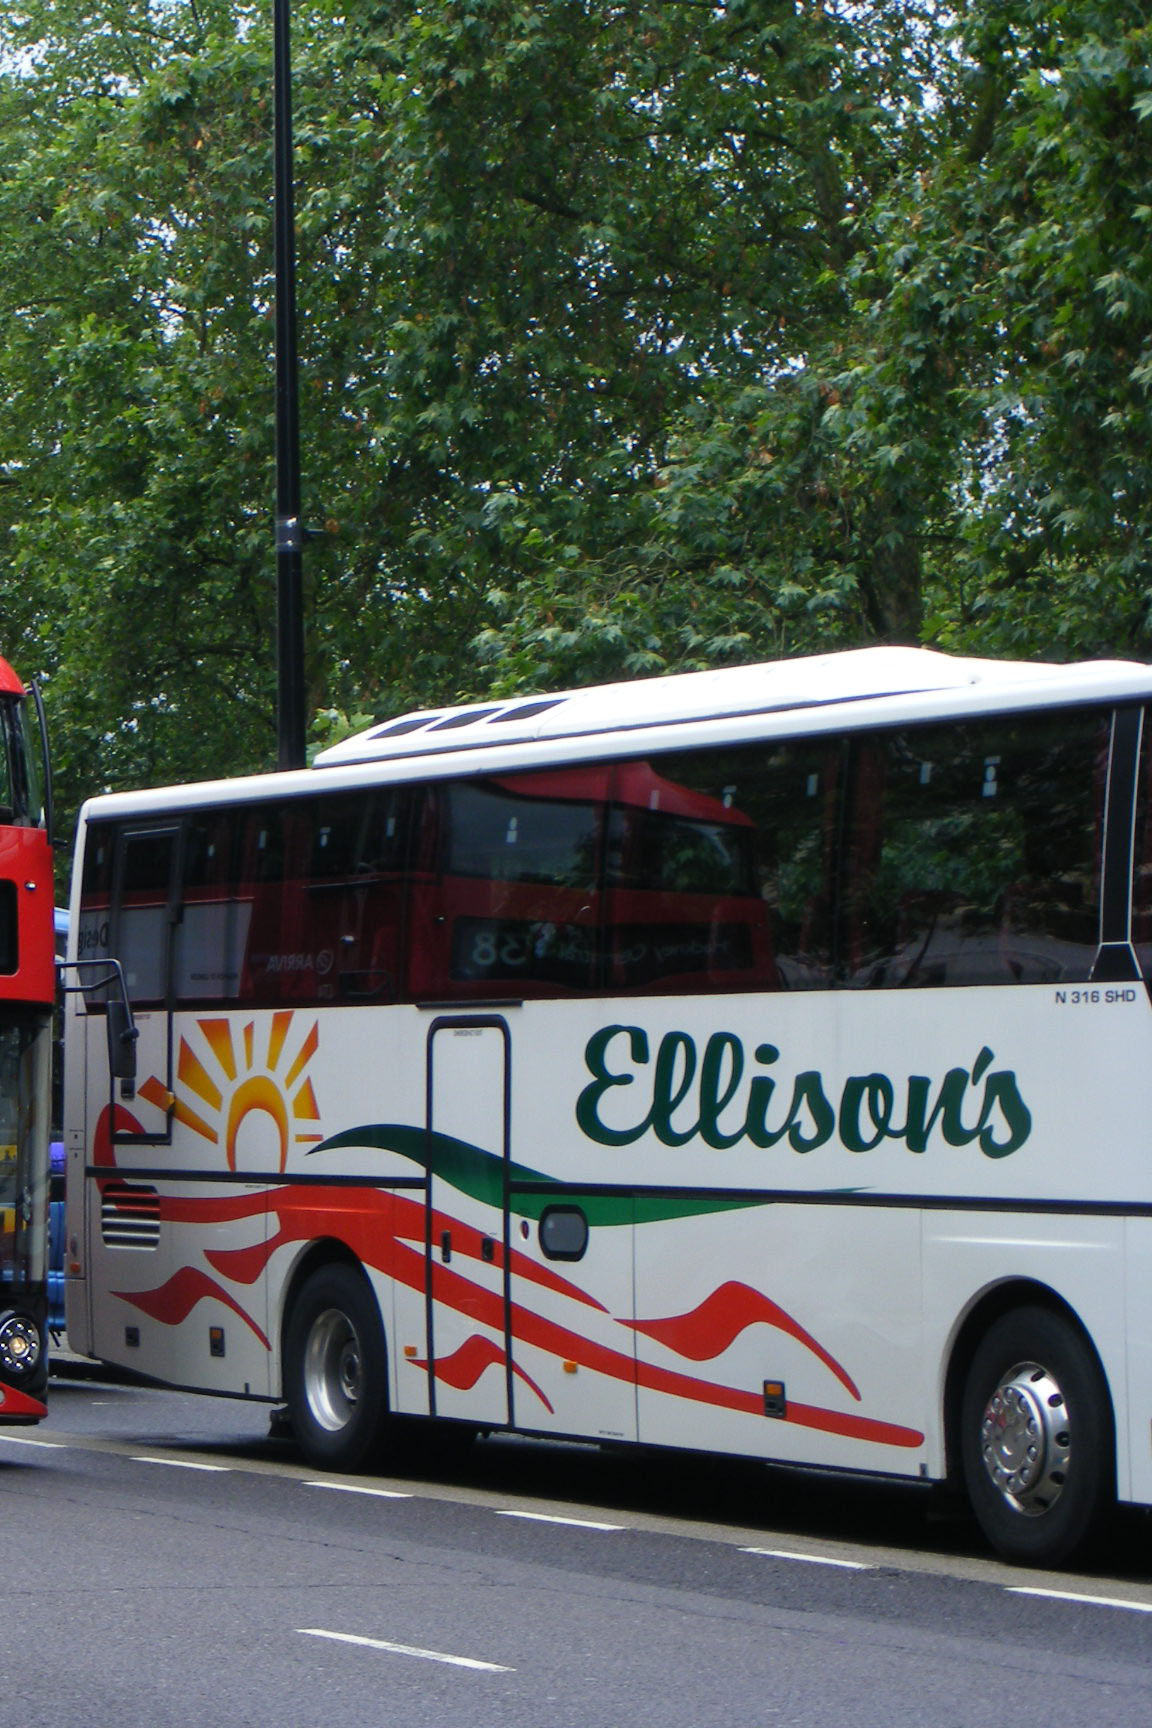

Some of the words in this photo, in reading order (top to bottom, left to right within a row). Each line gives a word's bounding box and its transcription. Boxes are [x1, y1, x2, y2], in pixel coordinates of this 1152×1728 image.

[1055, 991, 1067, 1004] N
[1071, 990, 1100, 1004] 316
[1105, 989, 1136, 1003] SHD
[576, 1024, 1032, 1159] Ellison's
